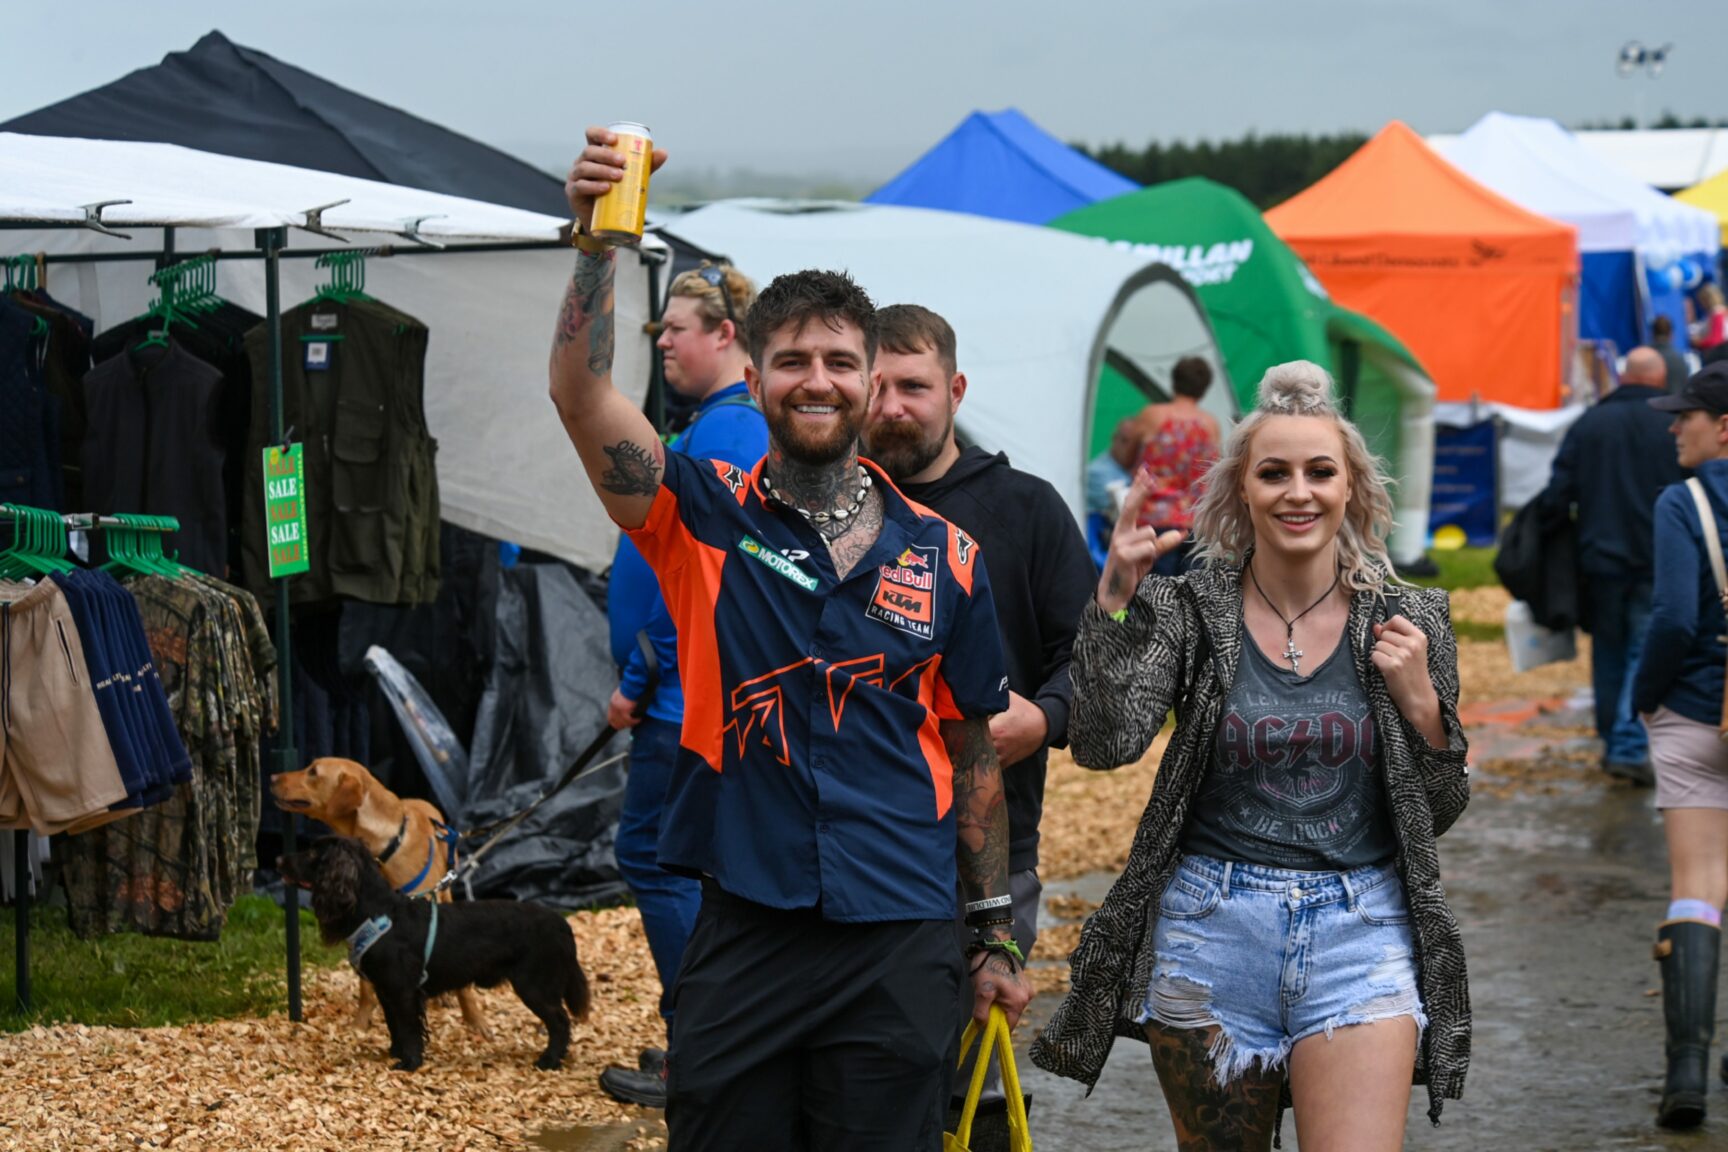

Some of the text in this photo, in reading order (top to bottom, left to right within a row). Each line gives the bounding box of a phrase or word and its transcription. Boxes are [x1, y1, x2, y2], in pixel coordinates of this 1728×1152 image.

[269, 478, 297, 500] SALE
[270, 501, 298, 523] SALE
[271, 522, 300, 545] SALE
[273, 544, 301, 567] SALE
[758, 547, 815, 590] MOTOREX
[902, 568, 933, 590] Bull
[882, 590, 922, 613] KTM
[871, 606, 930, 635] RACING TEAM
[1253, 815, 1283, 838] BE
